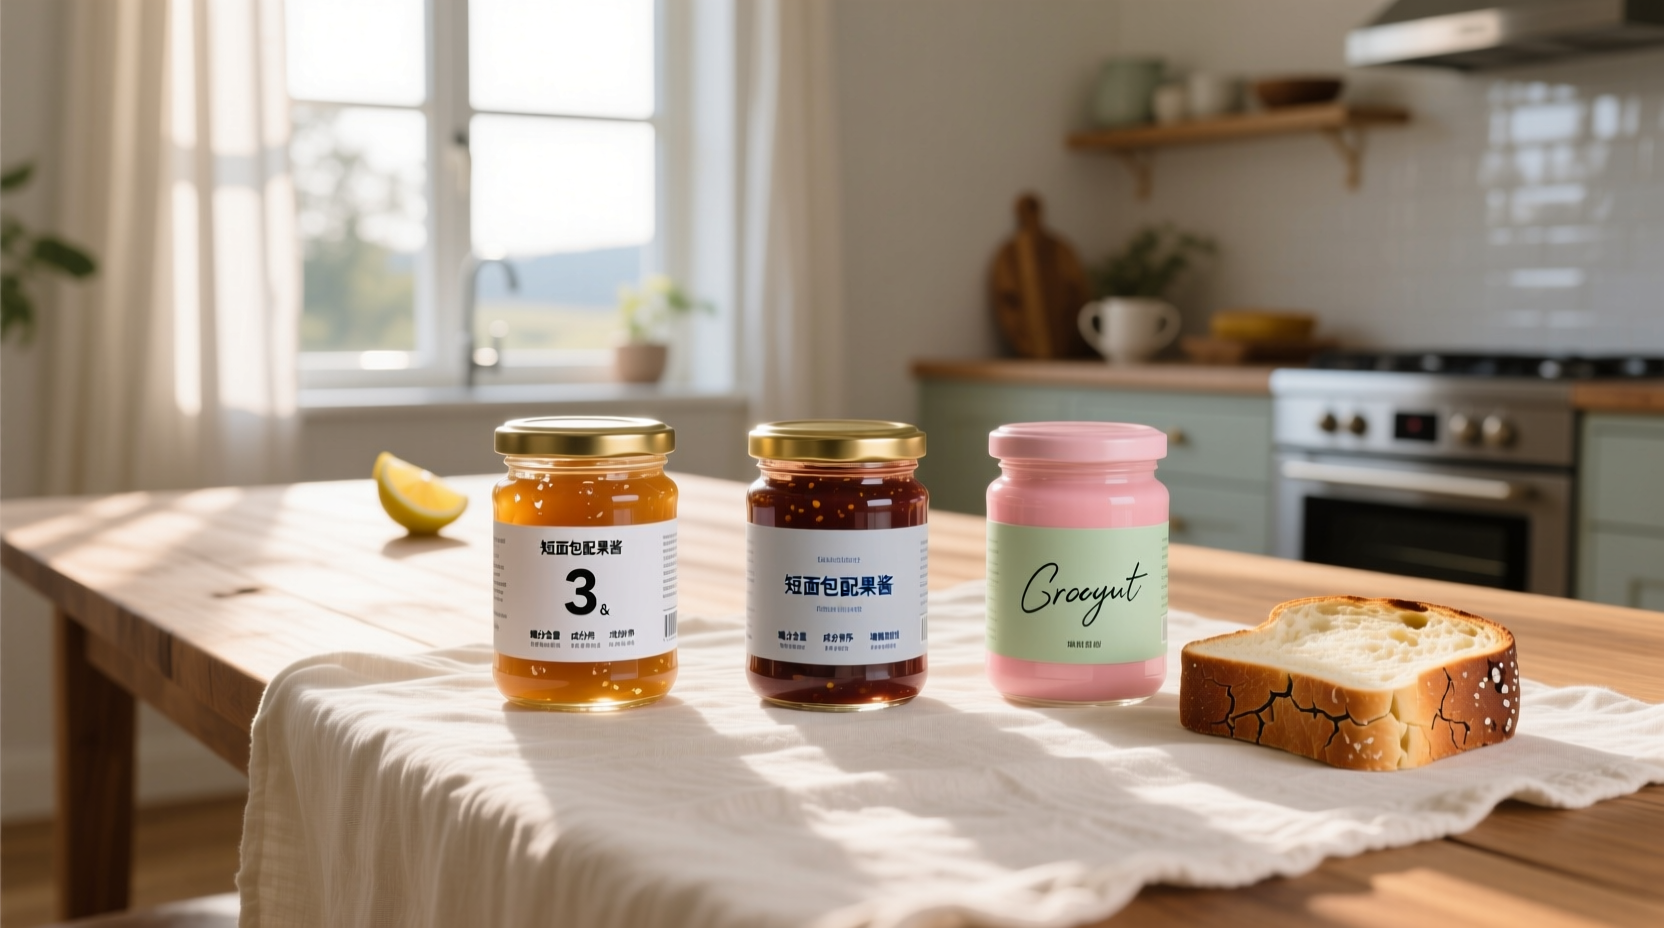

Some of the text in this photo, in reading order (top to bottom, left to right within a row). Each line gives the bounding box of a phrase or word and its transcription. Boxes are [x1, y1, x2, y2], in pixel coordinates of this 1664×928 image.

[540, 539, 623, 556] 短面包配果酱
[564, 568, 610, 616] 3 &
[784, 574, 894, 597] 短面包配果酱
